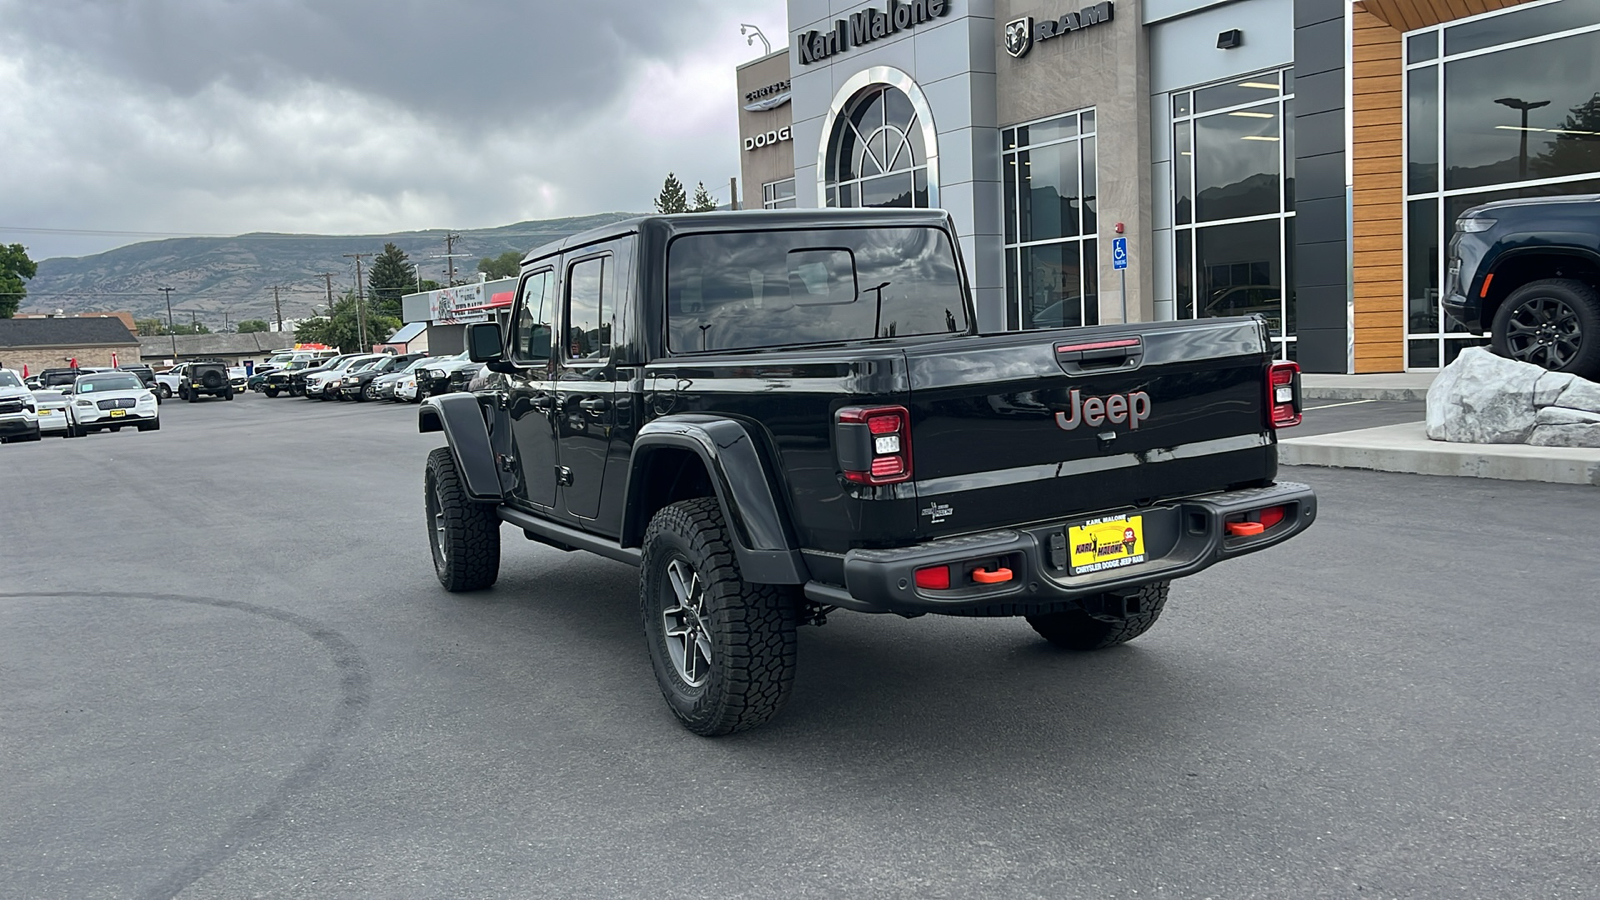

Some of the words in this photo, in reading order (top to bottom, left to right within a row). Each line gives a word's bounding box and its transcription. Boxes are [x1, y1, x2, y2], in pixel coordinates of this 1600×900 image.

[798, 19, 848, 65] Karl
[850, 0, 949, 47] Malone
[1035, 1, 1114, 42] RAM
[745, 79, 791, 101] CHRYSLE
[744, 125, 793, 151] DODG
[1055, 389, 1151, 431] Jeep
[1086, 518, 1102, 526] KARL
[1103, 514, 1126, 523] MALONE
[1125, 531, 1133, 539] 32
[1075, 542, 1093, 555] KARL
[1097, 543, 1123, 557] MALONE
[1075, 562, 1102, 574] CHRYSLER
[1102, 559, 1120, 569] DODGE
[1120, 557, 1132, 566] JEEP
[1132, 555, 1144, 564] RAM
